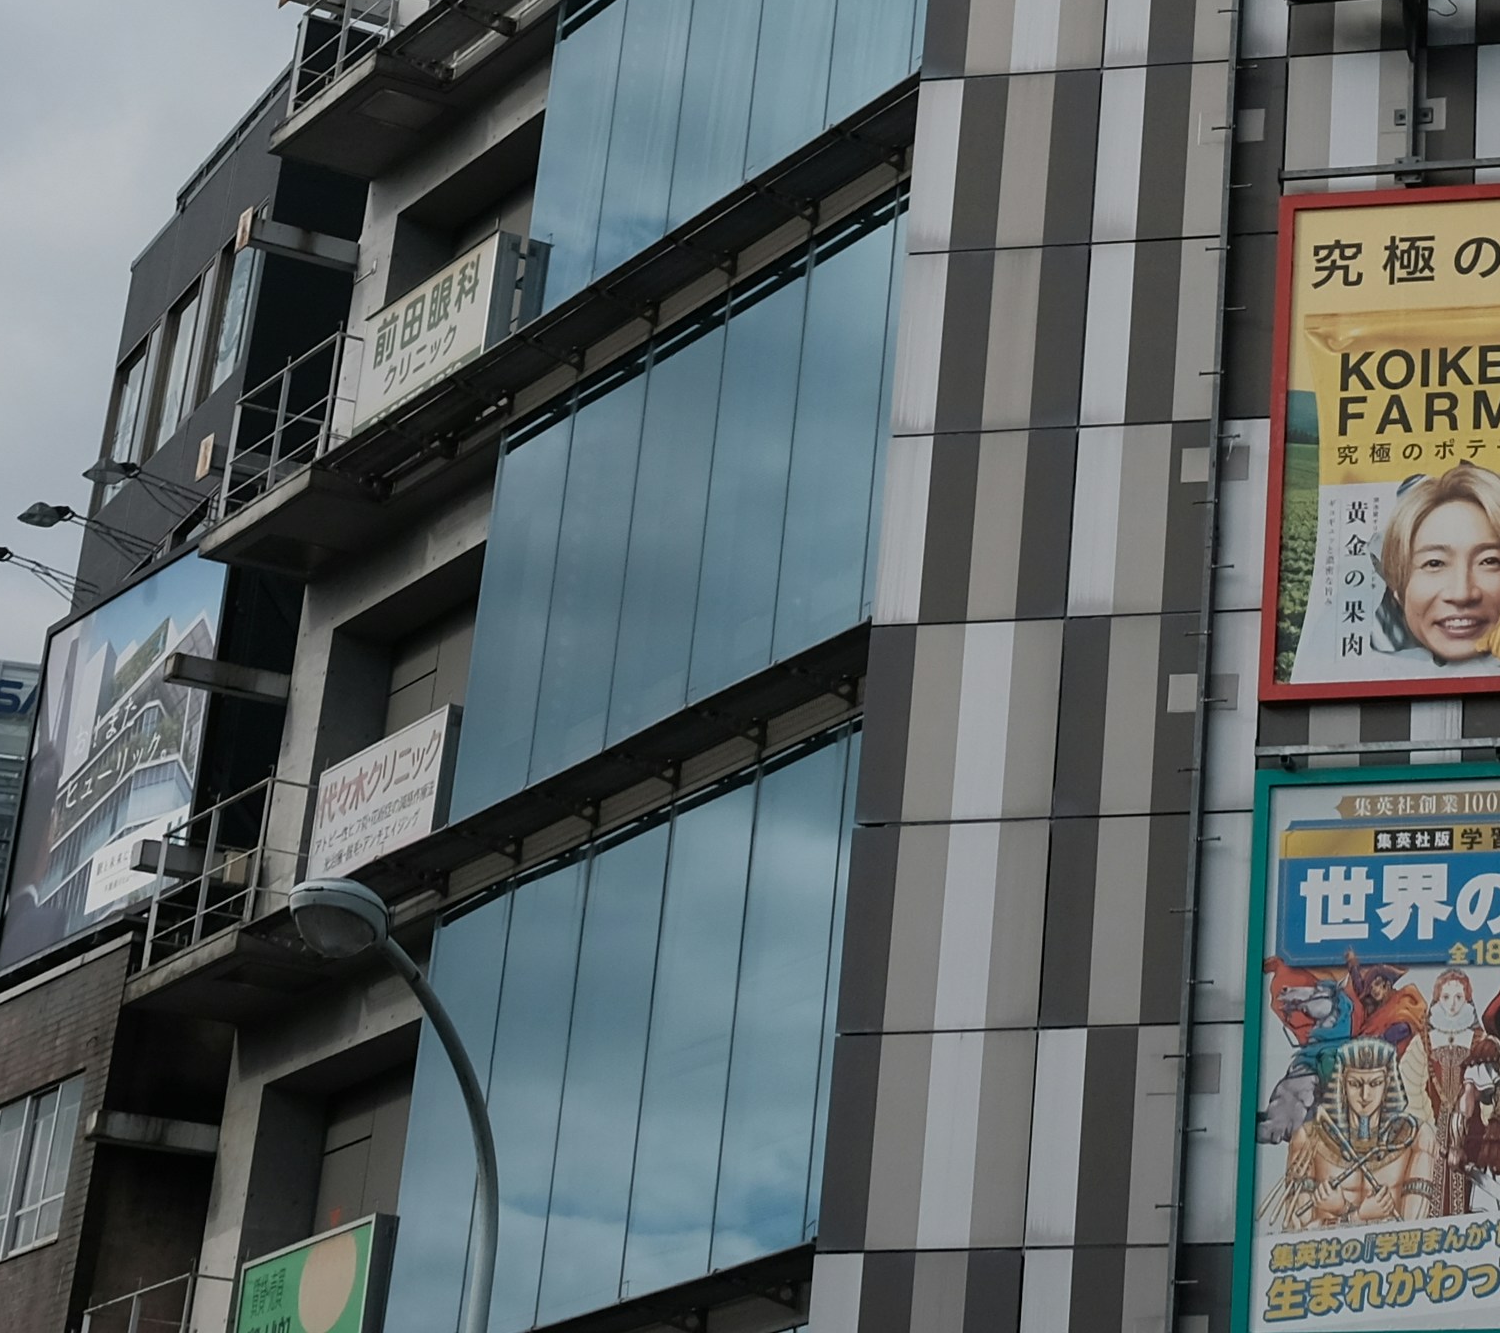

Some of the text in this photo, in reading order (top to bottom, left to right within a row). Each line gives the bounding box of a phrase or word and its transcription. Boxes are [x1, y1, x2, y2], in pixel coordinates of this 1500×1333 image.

[372, 253, 482, 370] 前田眼科
[383, 323, 458, 396] クリニック
[1341, 500, 1369, 658] 黄金の果肉
[317, 729, 442, 830] 代々木クリニック
[1376, 829, 1452, 850] 集英社版
[1268, 1219, 1491, 1273] 集英社の『学習まんが
